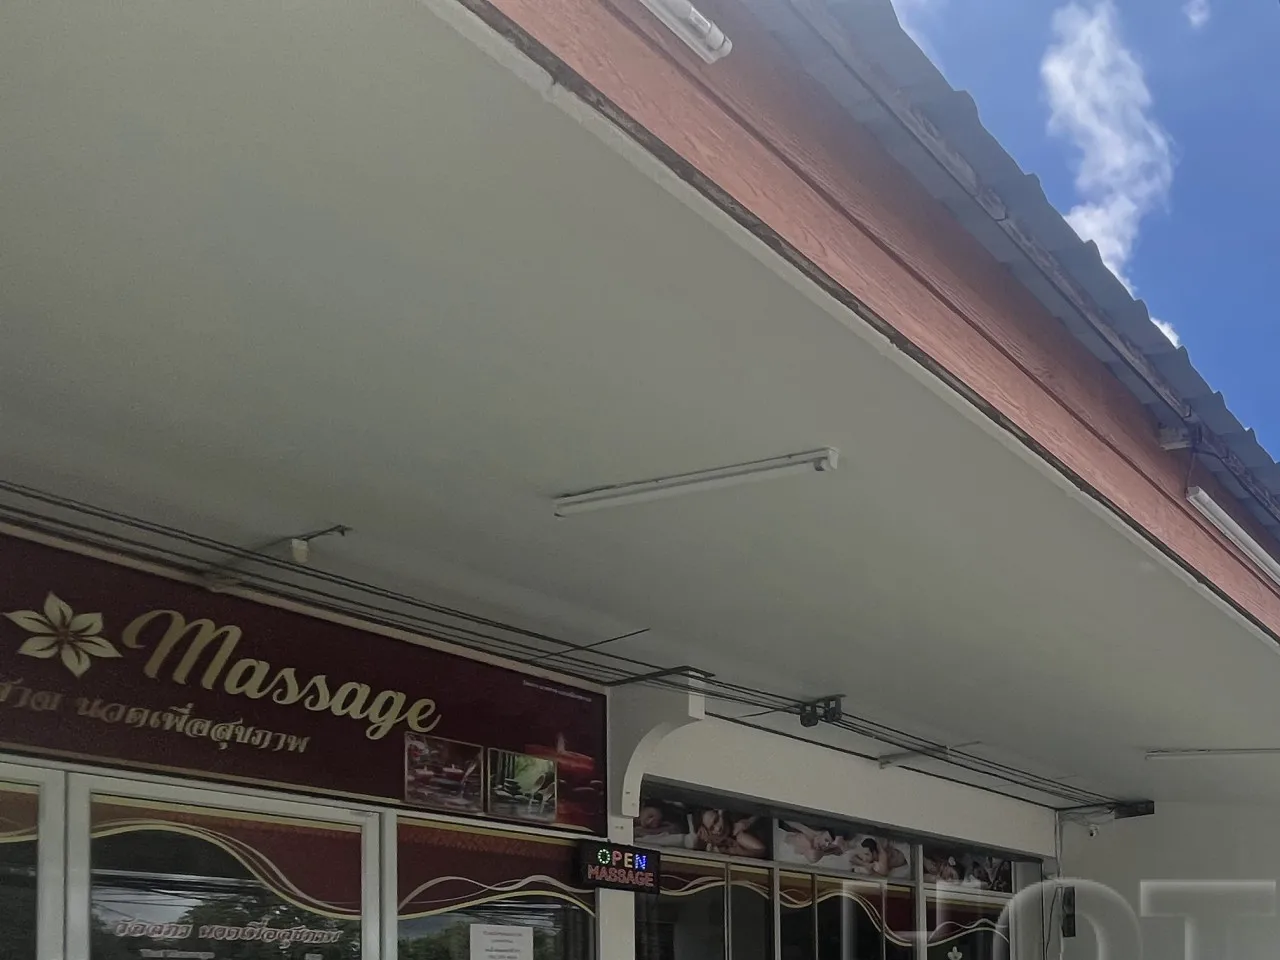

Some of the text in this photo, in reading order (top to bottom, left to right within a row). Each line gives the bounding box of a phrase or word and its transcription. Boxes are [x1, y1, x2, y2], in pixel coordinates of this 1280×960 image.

[122, 608, 443, 741] Massage
[597, 848, 648, 870] OPEN
[587, 864, 655, 888] MASSAGE
